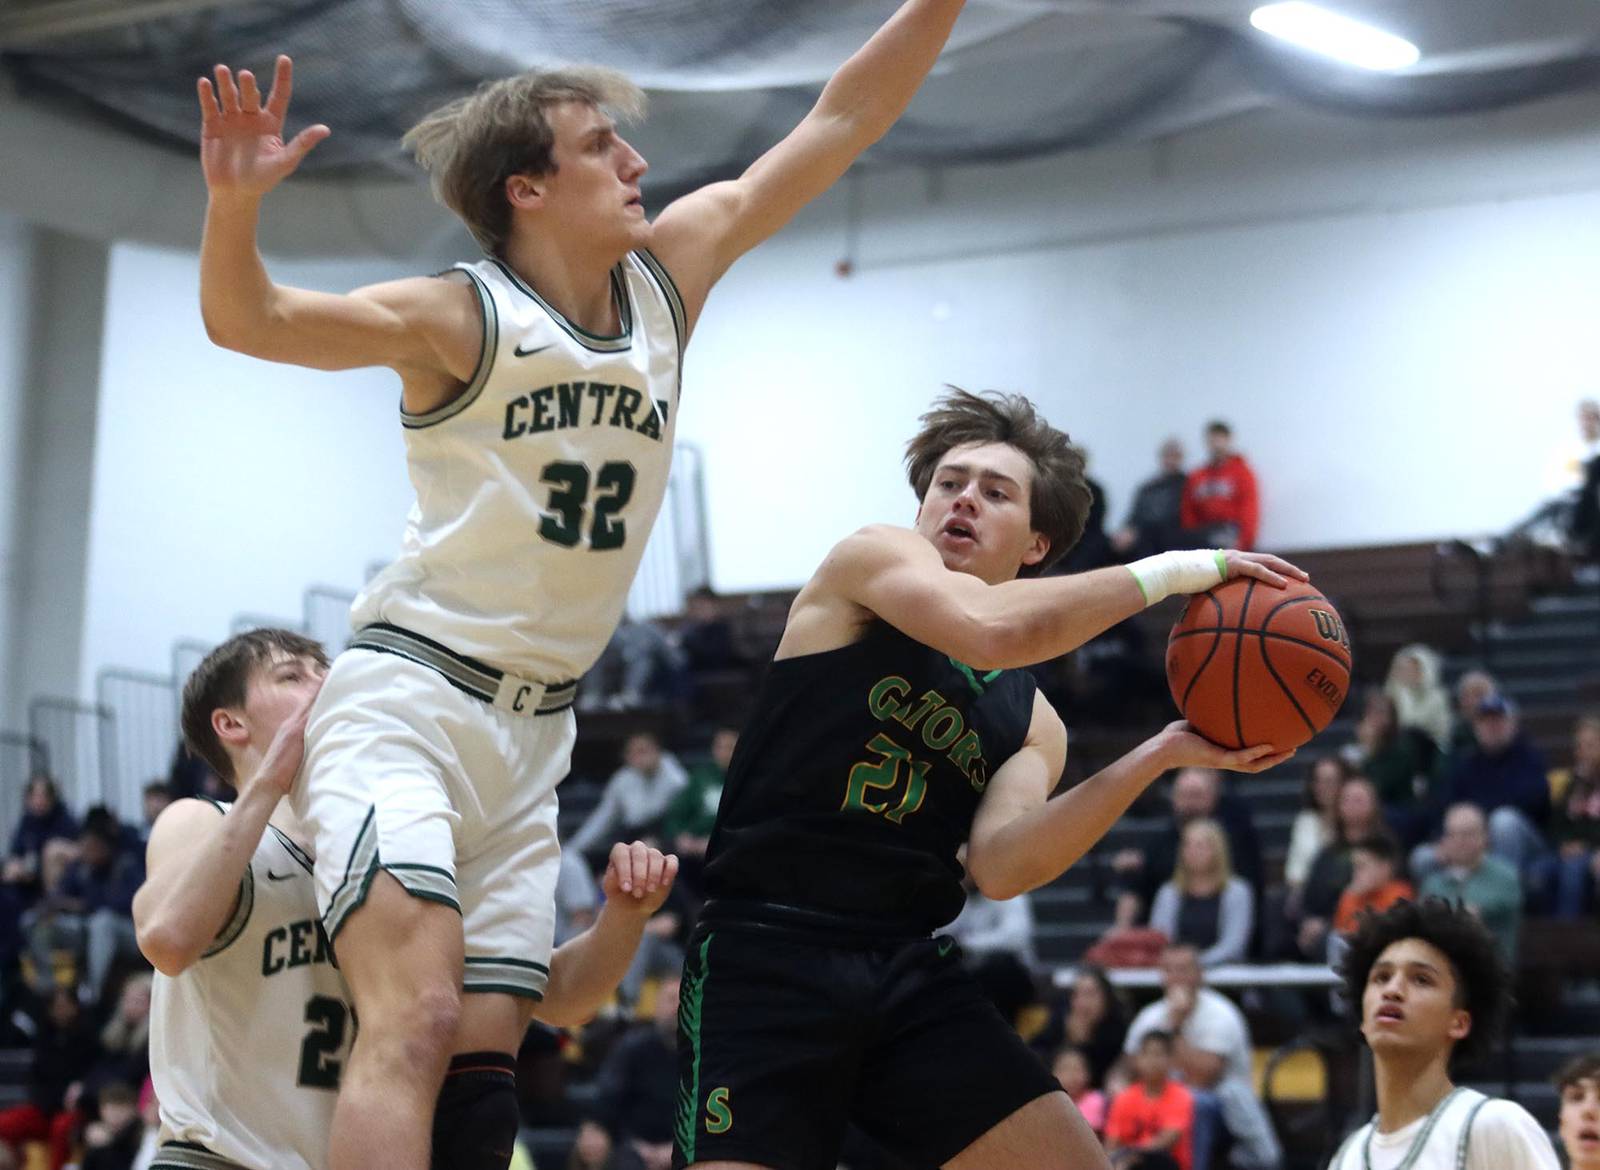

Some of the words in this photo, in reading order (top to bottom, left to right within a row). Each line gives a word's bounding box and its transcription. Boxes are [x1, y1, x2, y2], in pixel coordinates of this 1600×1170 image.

[537, 459, 637, 551] 32
[512, 686, 532, 712] C
[840, 732, 932, 824] 21
[296, 995, 359, 1093] 2
[705, 1087, 733, 1134] S
